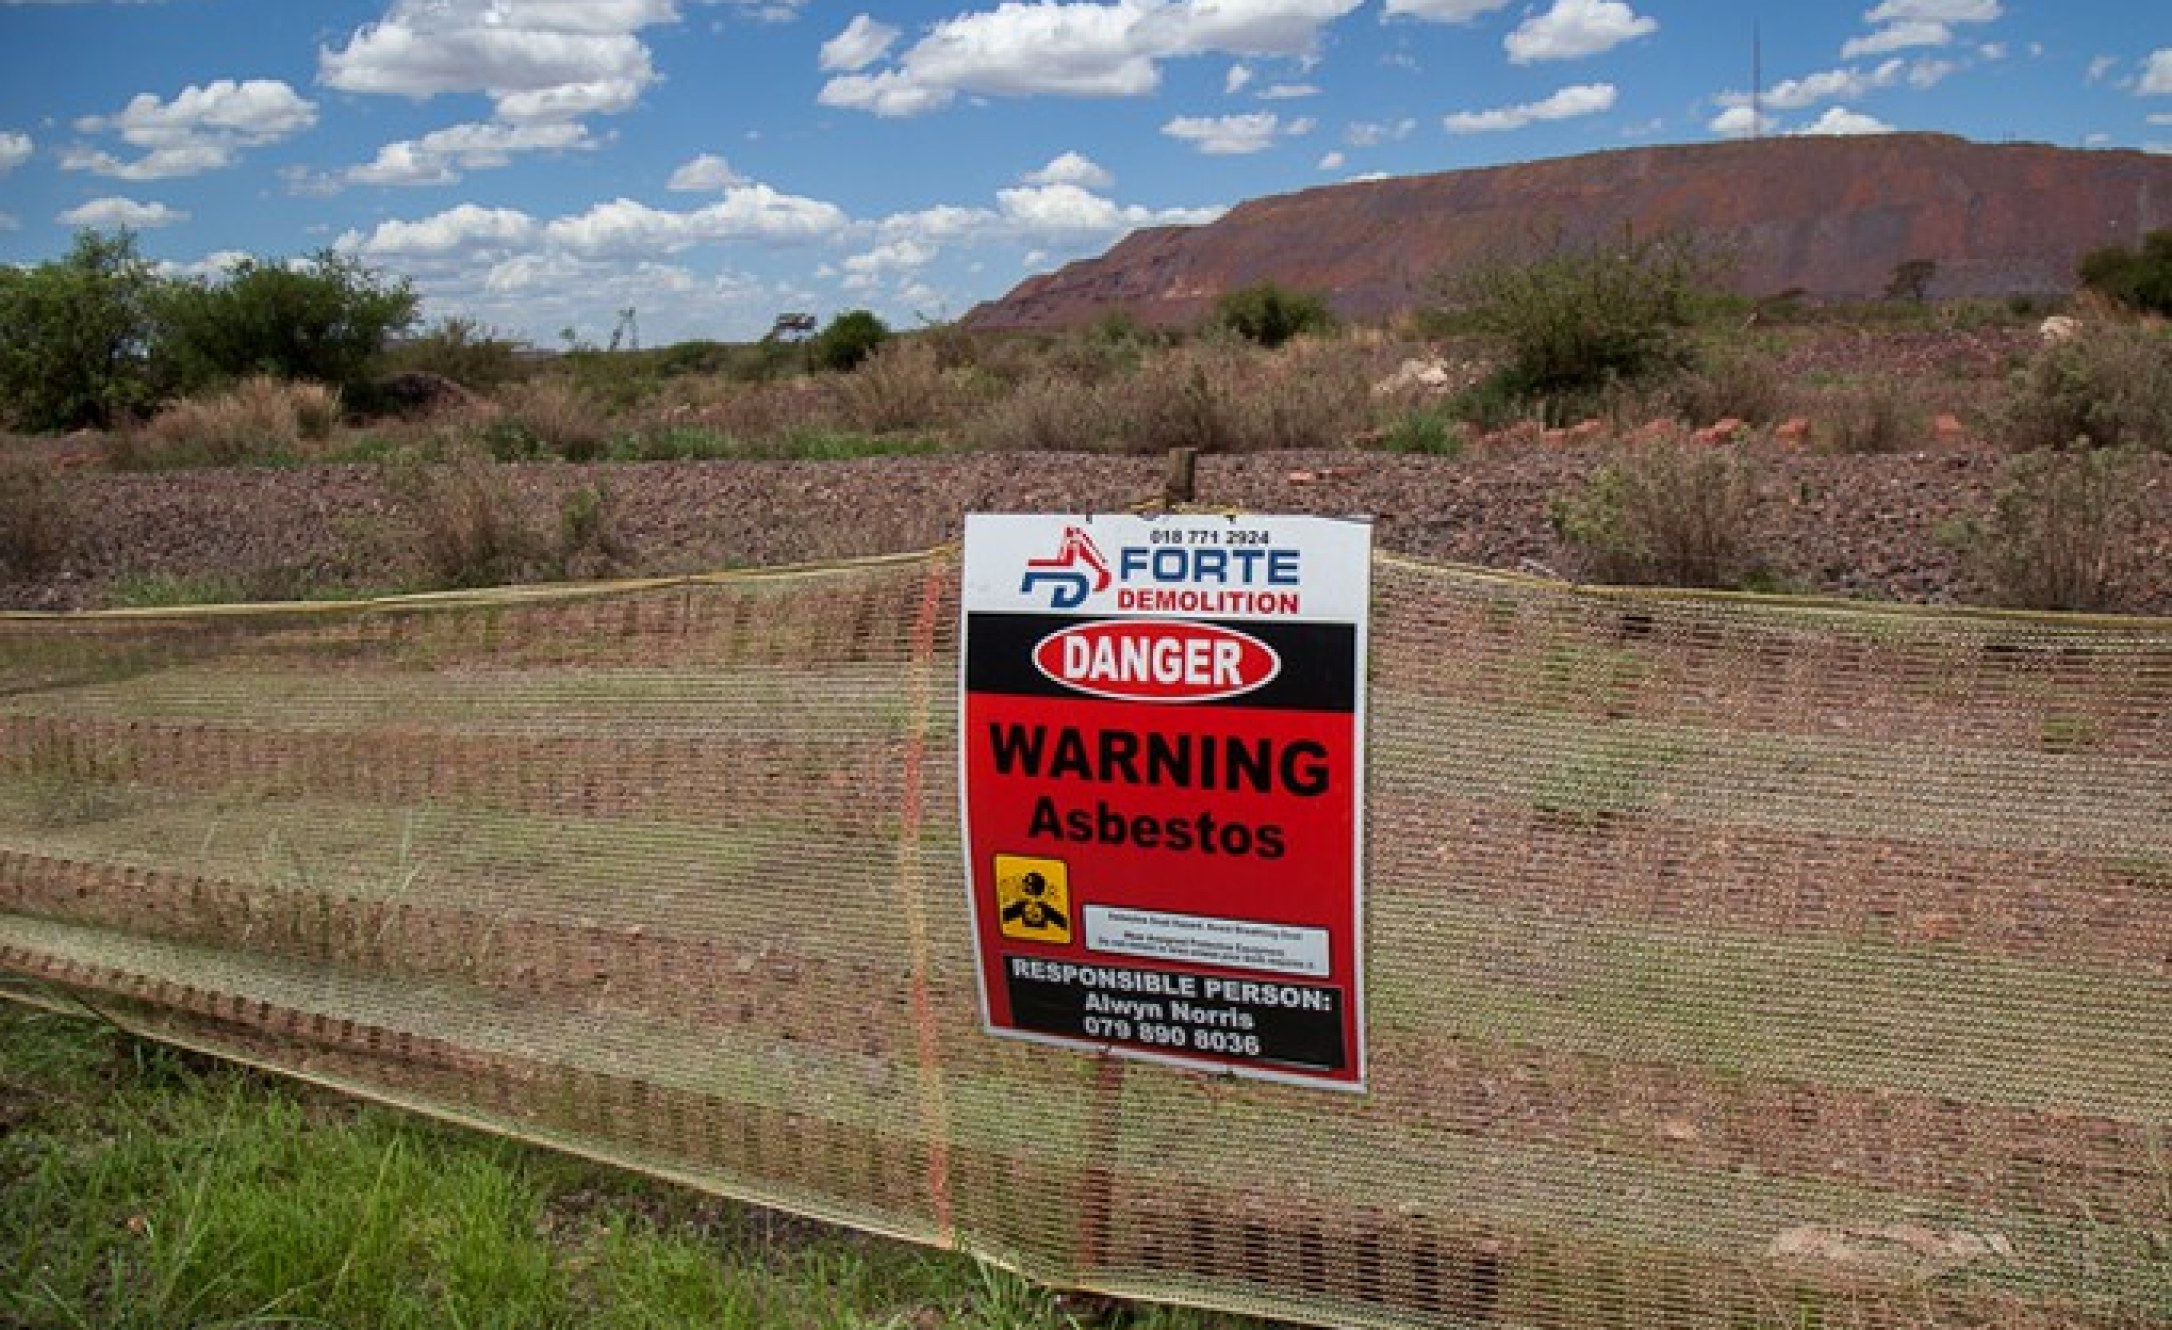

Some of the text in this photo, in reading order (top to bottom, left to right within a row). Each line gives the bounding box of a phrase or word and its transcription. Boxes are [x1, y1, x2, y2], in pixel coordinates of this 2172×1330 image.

[1187, 530, 1218, 544] 771
[1120, 546, 1299, 585] FORTE
[1117, 588, 1298, 614] DEMOLITION
[1063, 635, 1243, 686] DANGER
[988, 722, 1330, 796] WARNING
[1028, 796, 1285, 859] Asbestos
[1011, 958, 1332, 1011] RESPONSIBLE PERSON:
[1085, 991, 1254, 1030] Alwyn Norris
[1084, 1016, 1131, 1039] 079
[1139, 1022, 1186, 1046] 890
